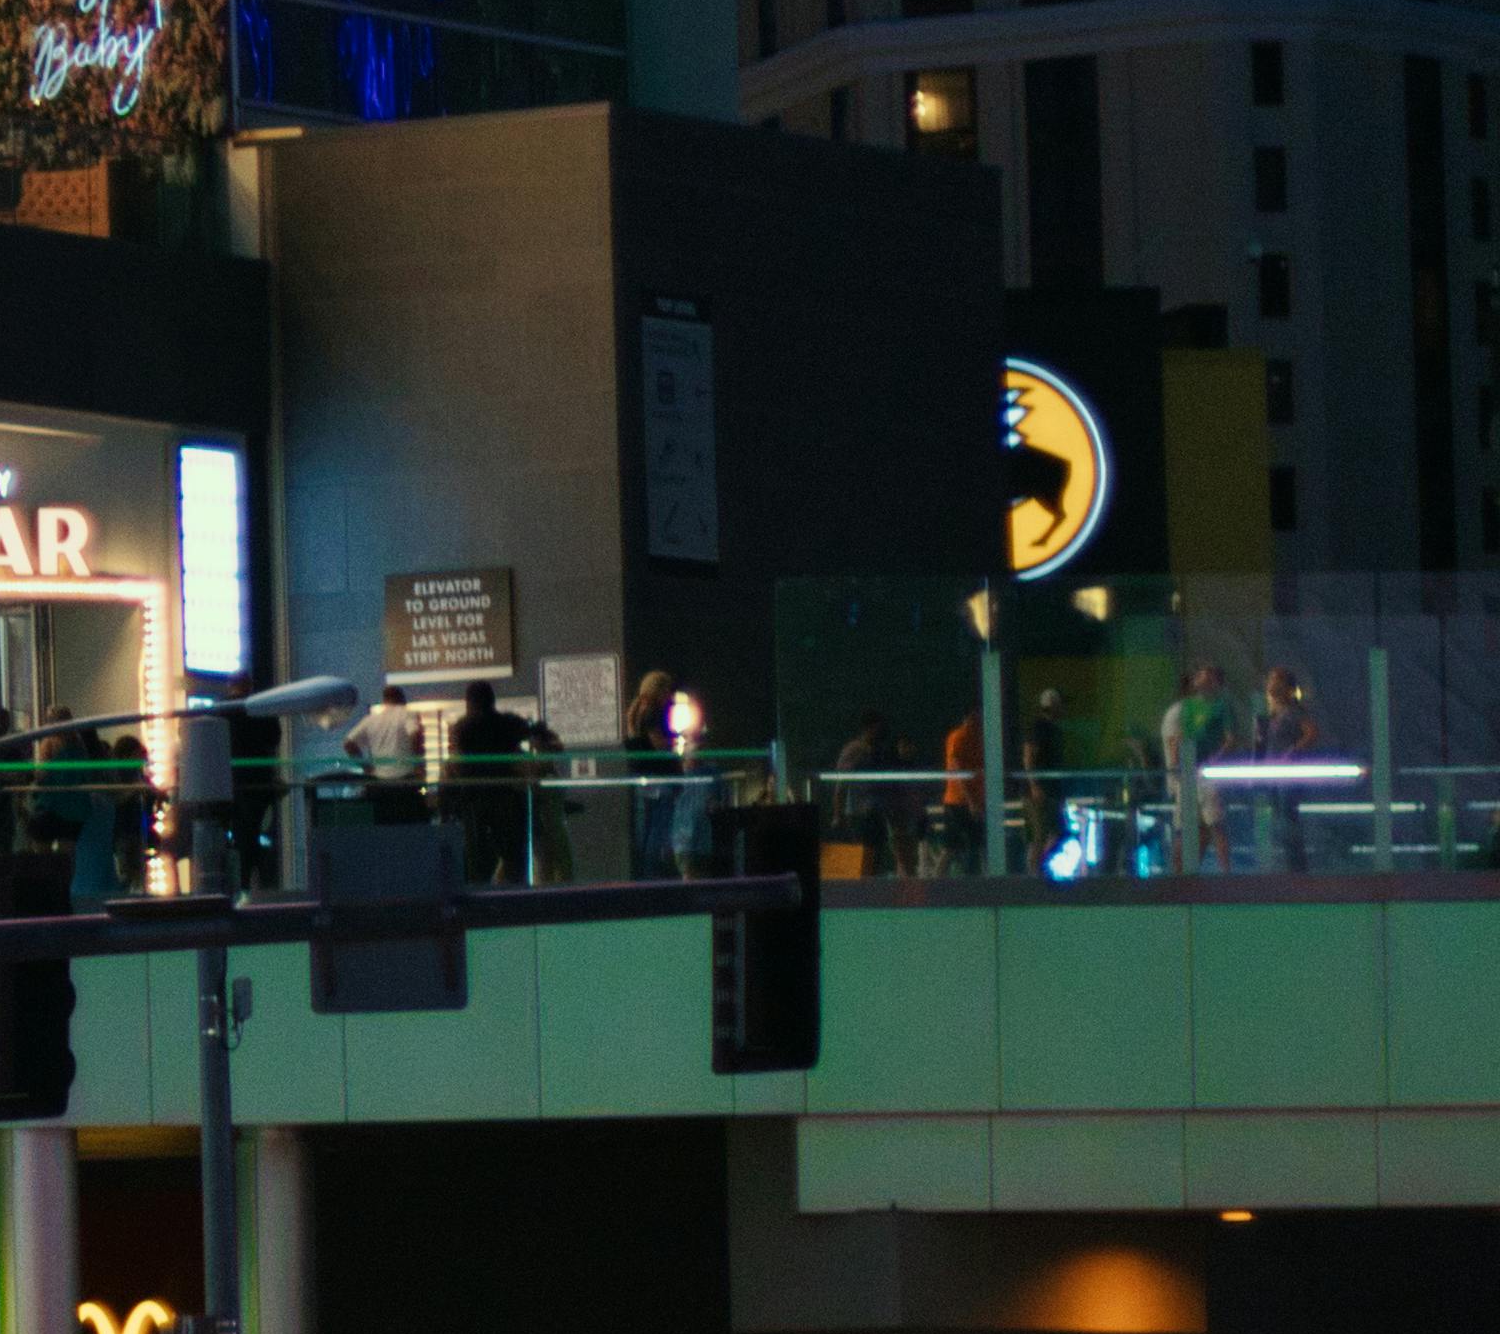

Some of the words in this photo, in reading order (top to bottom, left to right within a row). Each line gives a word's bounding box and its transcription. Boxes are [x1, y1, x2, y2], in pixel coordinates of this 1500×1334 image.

[414, 578, 482, 597] ELEVATOR
[405, 600, 424, 613] TO
[429, 594, 491, 611] GROUND
[413, 614, 452, 631] LEVEL
[456, 613, 484, 627] FOR
[412, 633, 437, 649] LAS
[442, 630, 487, 646] VEGAS
[404, 650, 441, 667] STRIP
[445, 647, 494, 663] NORTH
